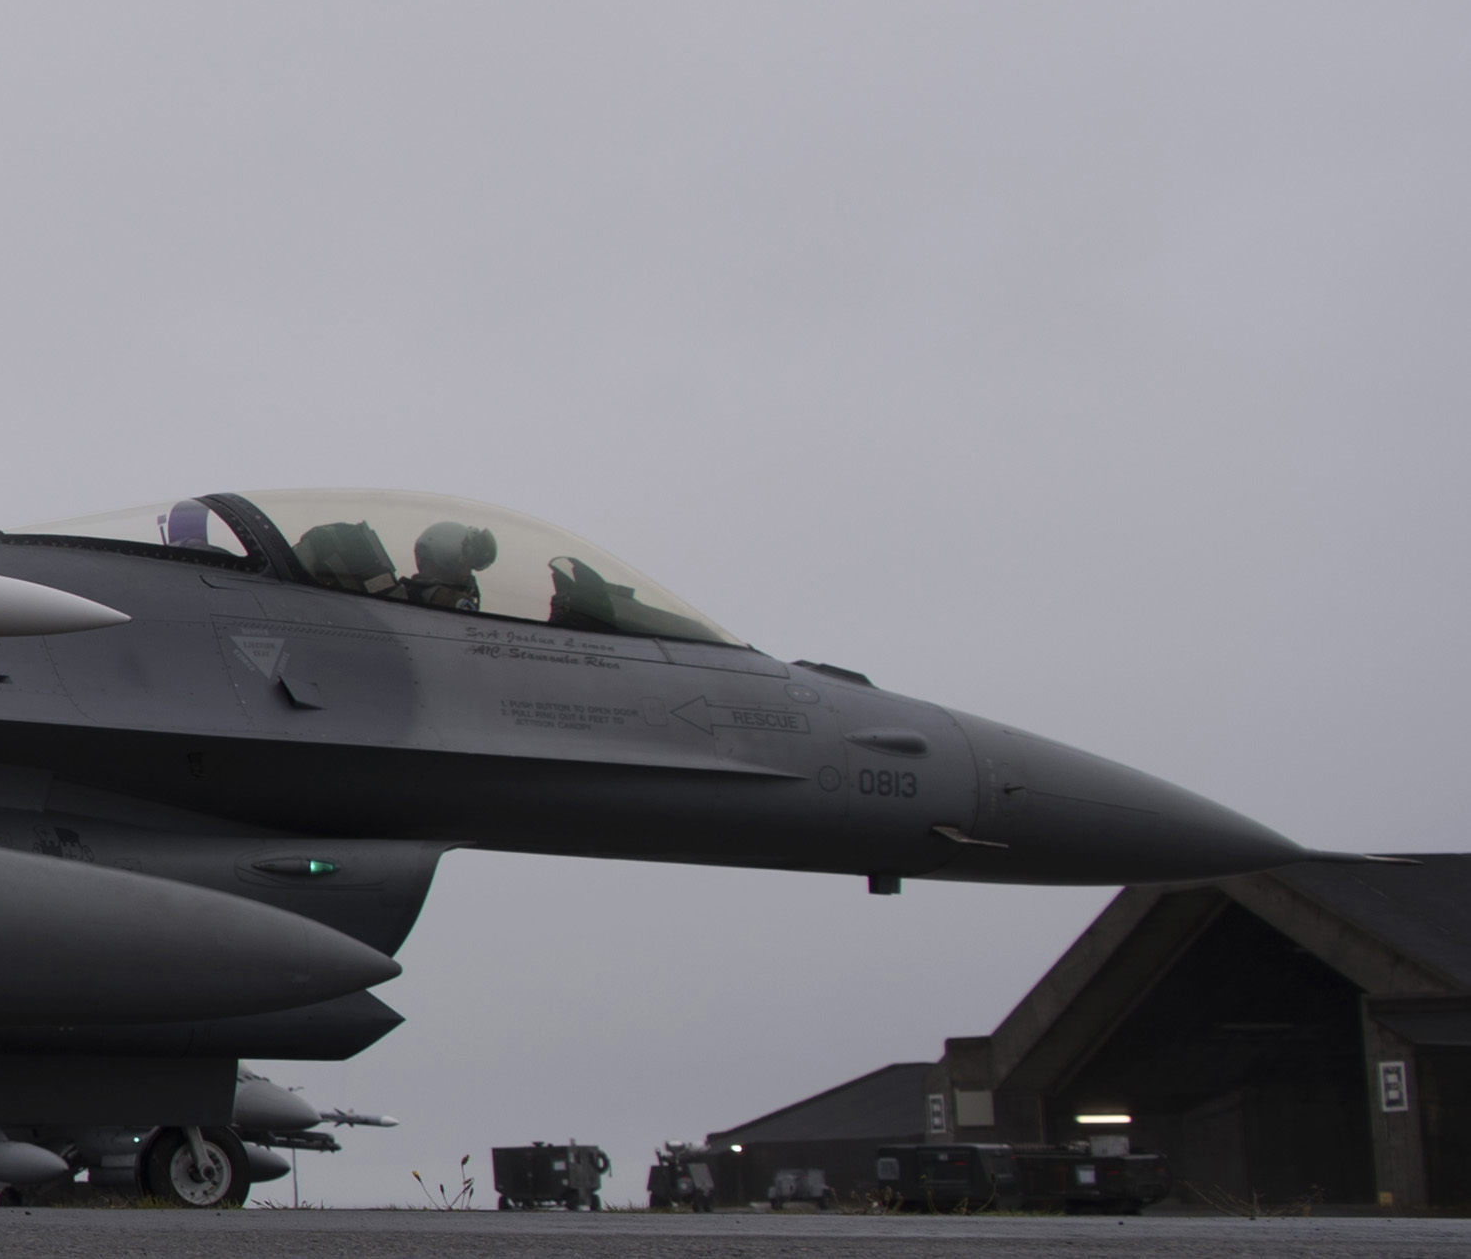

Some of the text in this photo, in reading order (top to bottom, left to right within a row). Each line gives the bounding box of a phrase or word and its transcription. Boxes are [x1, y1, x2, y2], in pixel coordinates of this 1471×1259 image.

[535, 702, 571, 712] BUTTON
[731, 709, 799, 730] RESCUE
[858, 768, 918, 798] 0813
